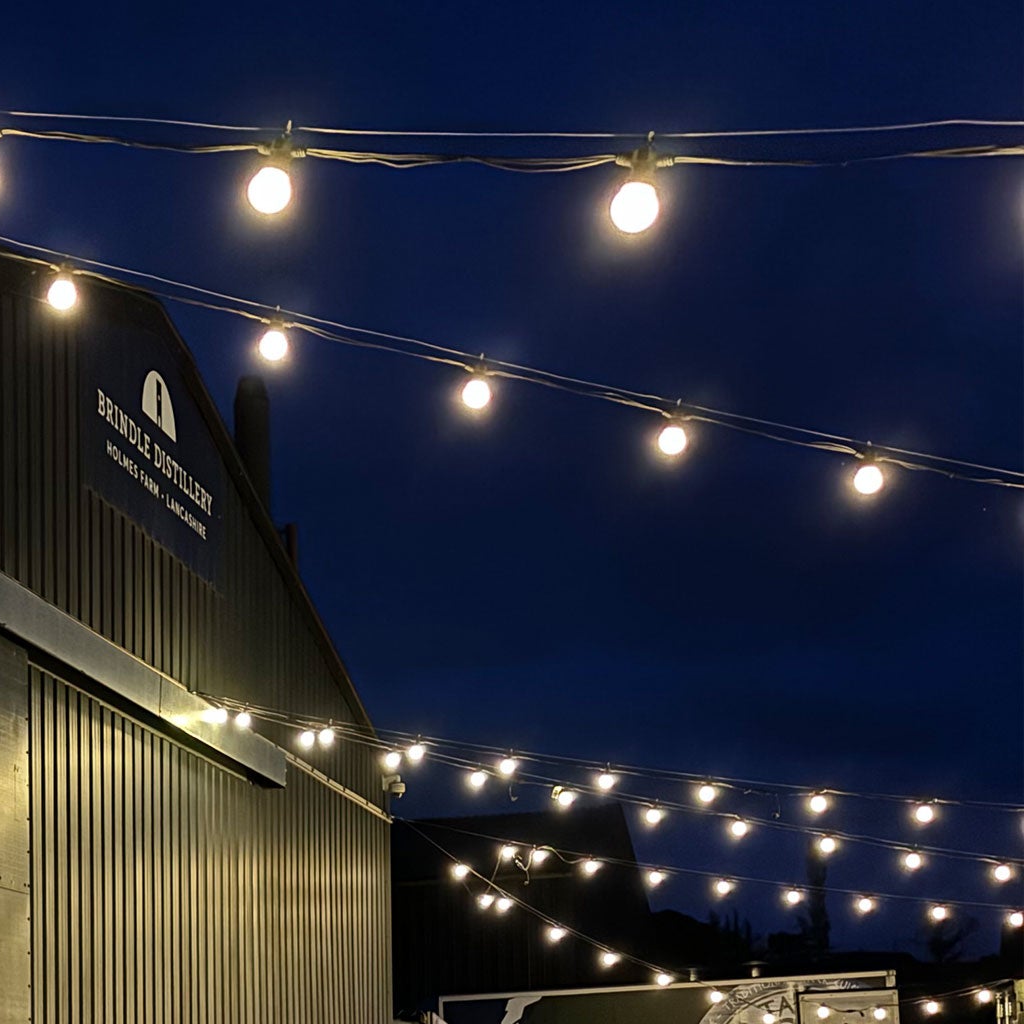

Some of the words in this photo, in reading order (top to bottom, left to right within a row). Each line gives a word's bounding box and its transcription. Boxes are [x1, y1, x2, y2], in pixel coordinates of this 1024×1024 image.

[97, 388, 151, 460] BRINDLE
[153, 442, 213, 516] DISTILLERY
[106, 439, 139, 479] HOLMES
[140, 470, 160, 498] FARM
[166, 493, 207, 540] LANCASHIRE
